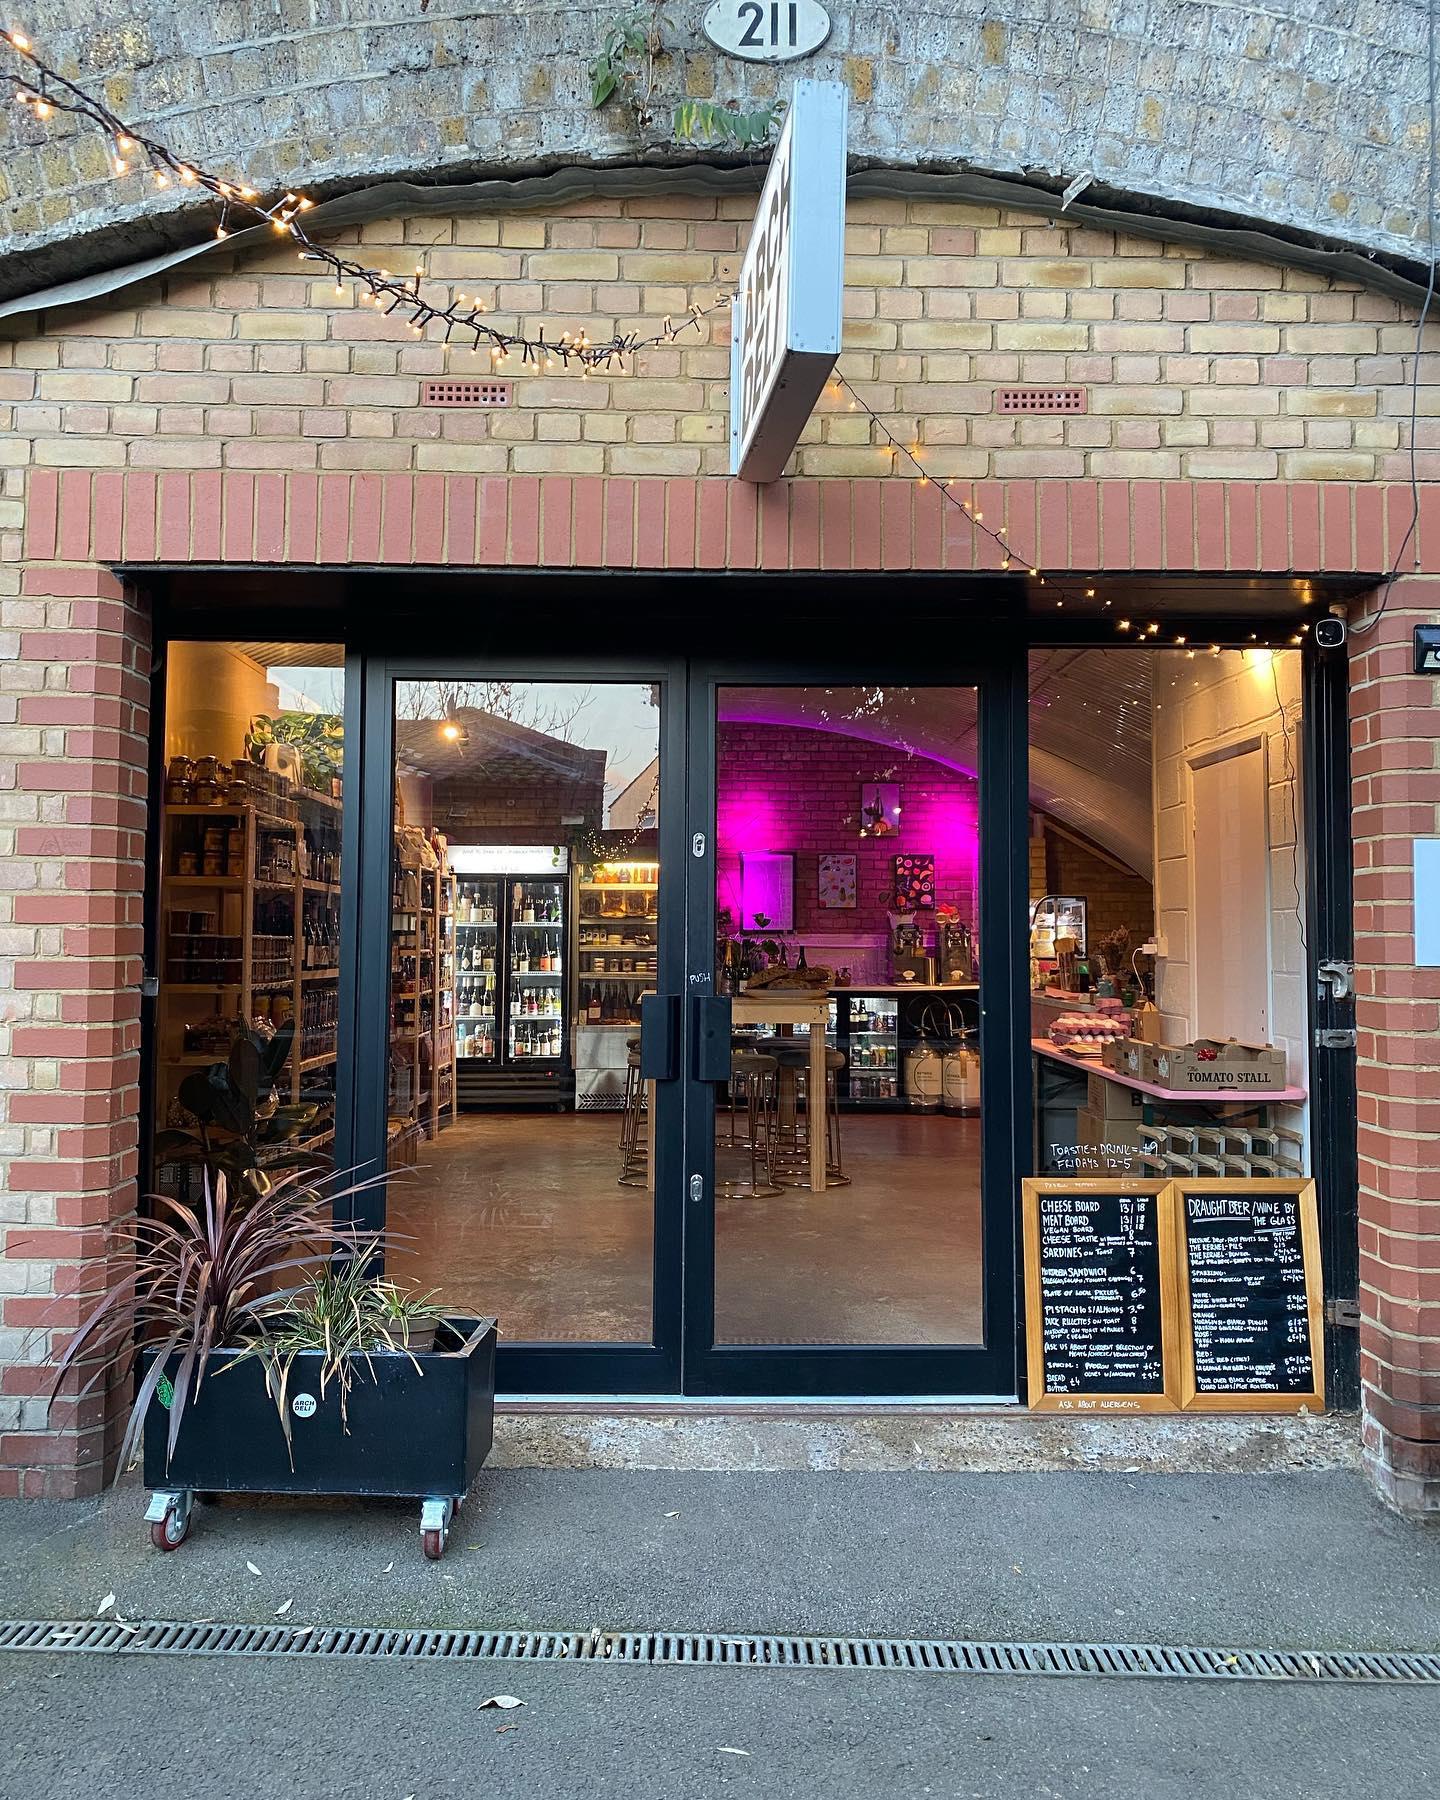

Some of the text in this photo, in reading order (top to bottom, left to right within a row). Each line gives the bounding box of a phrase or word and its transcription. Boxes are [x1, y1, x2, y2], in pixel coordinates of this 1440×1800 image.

[738, 2, 796, 46] 211
[741, 138, 792, 366] ARCH
[741, 265, 782, 446] DELI
[690, 972, 710, 984] PUSH
[1187, 1072, 1271, 1082] TOMATO STALL
[1107, 1158, 1132, 1169] 12-5
[1041, 1200, 1072, 1212] CHEESE
[1075, 1201, 1100, 1212] BOARD
[1188, 1199, 1228, 1216] DRAUGHT
[1284, 1202, 1296, 1214] BY
[1042, 1215, 1063, 1226] MEAT
[1065, 1215, 1089, 1226] BOARD
[1252, 1216, 1296, 1226] THE GLASS
[1042, 1235, 1071, 1244] CHEESE
[1042, 1247, 1082, 1258] SARDINES
[1095, 1248, 1114, 1256] TOAST
[1128, 1248, 1135, 1258] 7
[1189, 1244, 1201, 1252] THE
[1190, 1252, 1202, 1260] THE
[1068, 1267, 1107, 1277] SANDWICH
[1130, 1266, 1136, 1274] 6
[1132, 1316, 1137, 1324] 8
[1078, 1400, 1096, 1408] ABOUT
